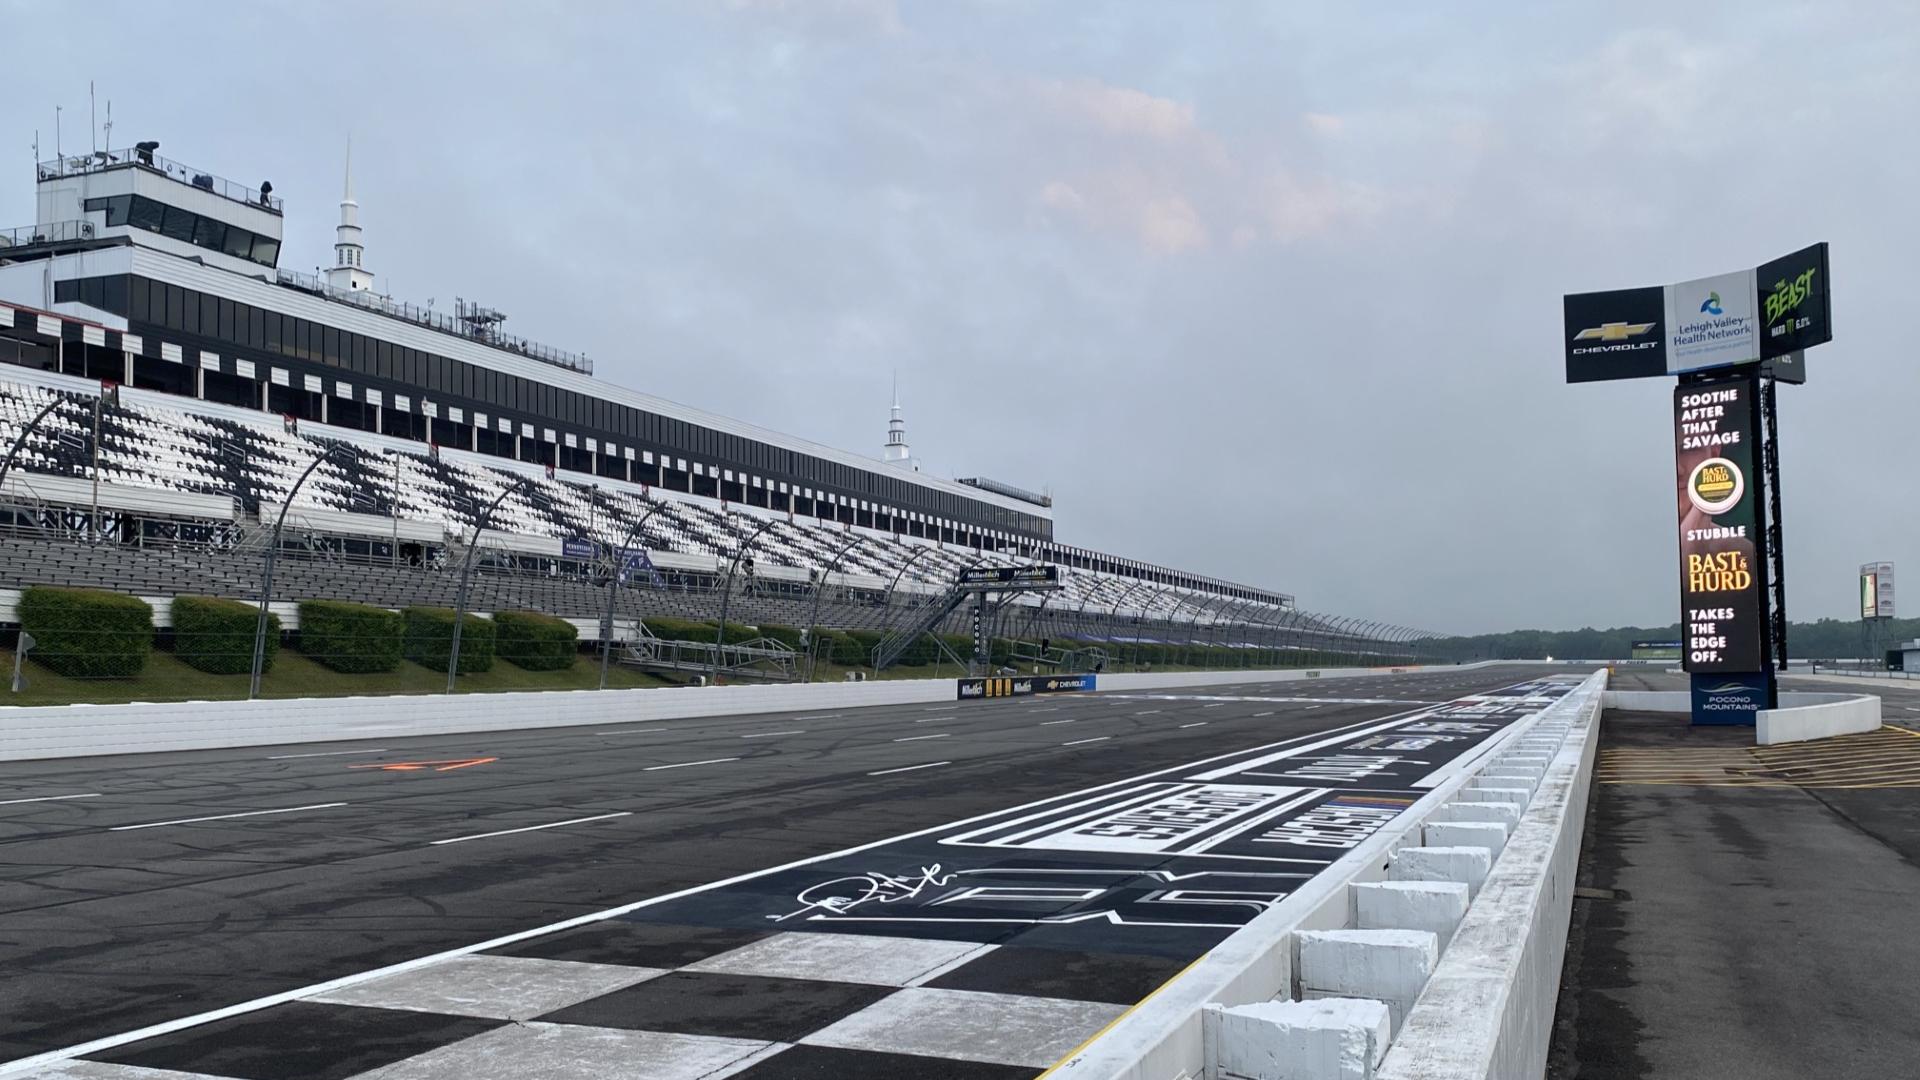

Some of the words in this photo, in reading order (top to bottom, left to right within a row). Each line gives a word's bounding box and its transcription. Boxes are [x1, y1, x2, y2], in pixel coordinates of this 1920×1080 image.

[1763, 267, 1816, 327] BEAST
[1679, 319, 1712, 335] Lehigh
[1713, 316, 1744, 330] Valley
[1673, 331, 1706, 346] Health
[1707, 325, 1751, 341] Network
[1573, 341, 1658, 354] CHEVROLET
[1681, 389, 1738, 408] SOOTHE
[1682, 405, 1724, 421] AFTER
[1682, 420, 1718, 435] THAT
[1683, 431, 1740, 449] SAVAGE
[1687, 526, 1746, 541] STUBBLE
[1689, 570, 1751, 592] HURD
[1689, 608, 1734, 621] TAKES
[1690, 623, 1715, 634] THE
[1690, 636, 1726, 649] EDGE
[1691, 651, 1723, 662] OFF.
[1060, 680, 1087, 689] CHEVROLET
[1703, 703, 1758, 711] MOUNTAINS
[1073, 804, 1241, 840] SERIES
[1251, 805, 1403, 848] NASCAR
